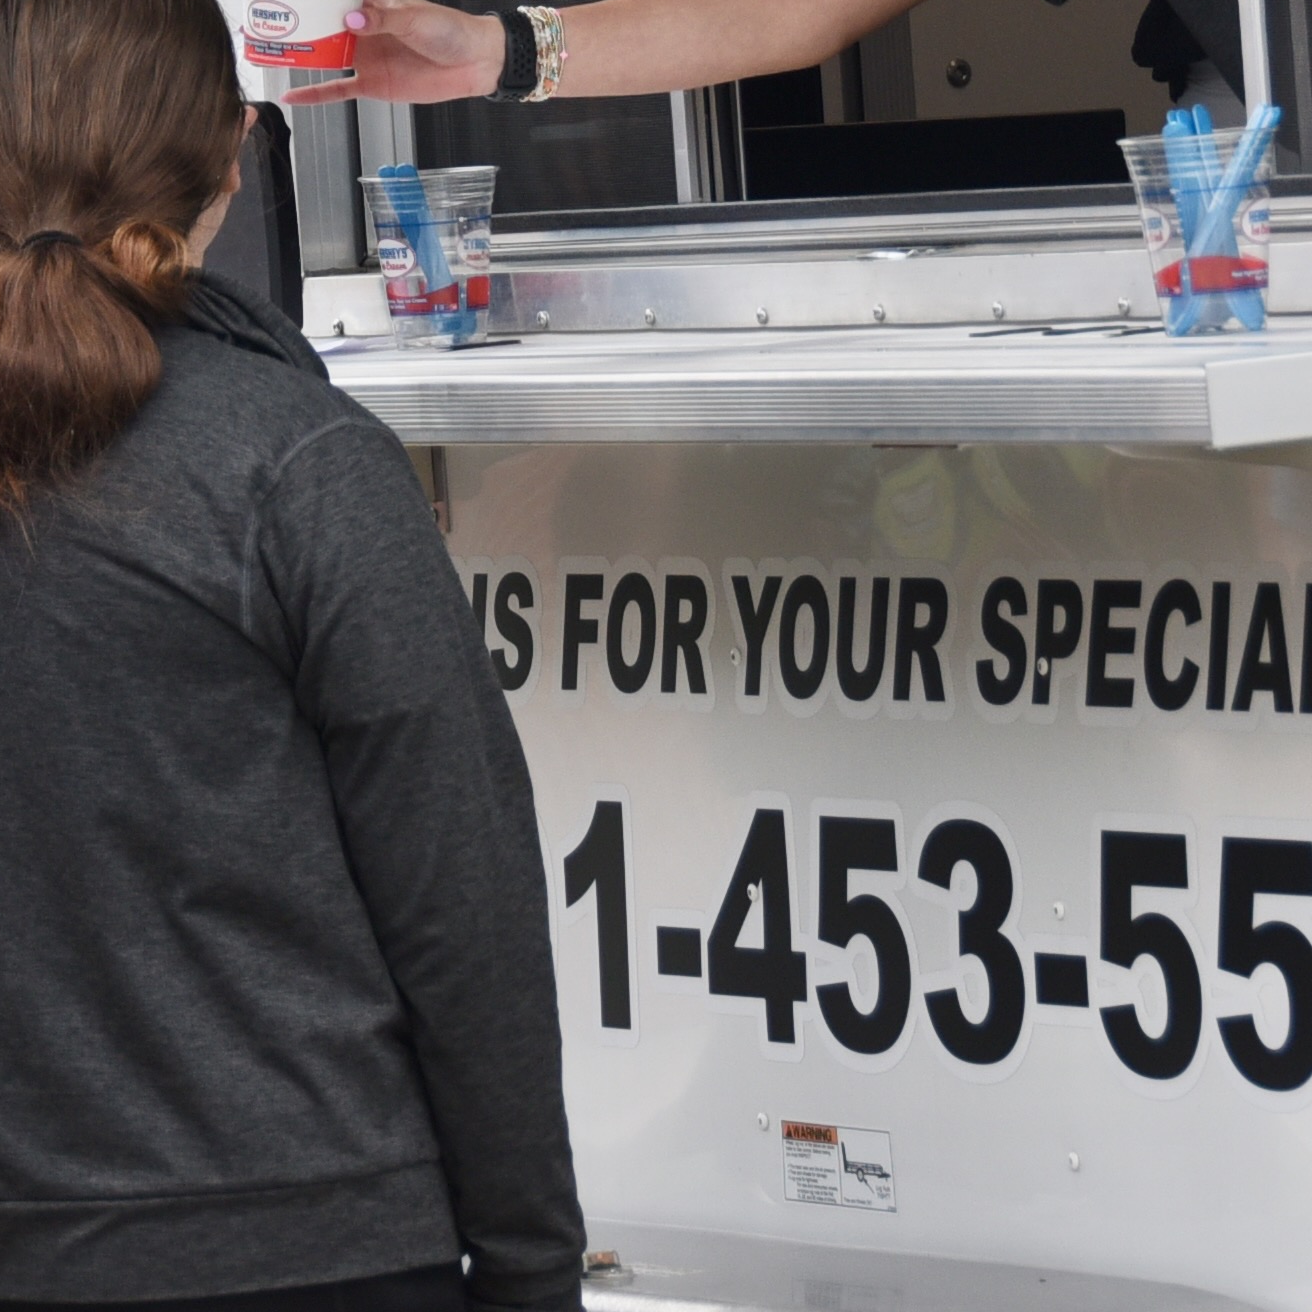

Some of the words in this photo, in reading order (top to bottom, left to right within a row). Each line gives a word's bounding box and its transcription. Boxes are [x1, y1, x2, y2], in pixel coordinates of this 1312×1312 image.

[561, 572, 707, 694] FOR
[731, 574, 948, 702] YOUR
[793, 1126, 832, 1142] WARNING
